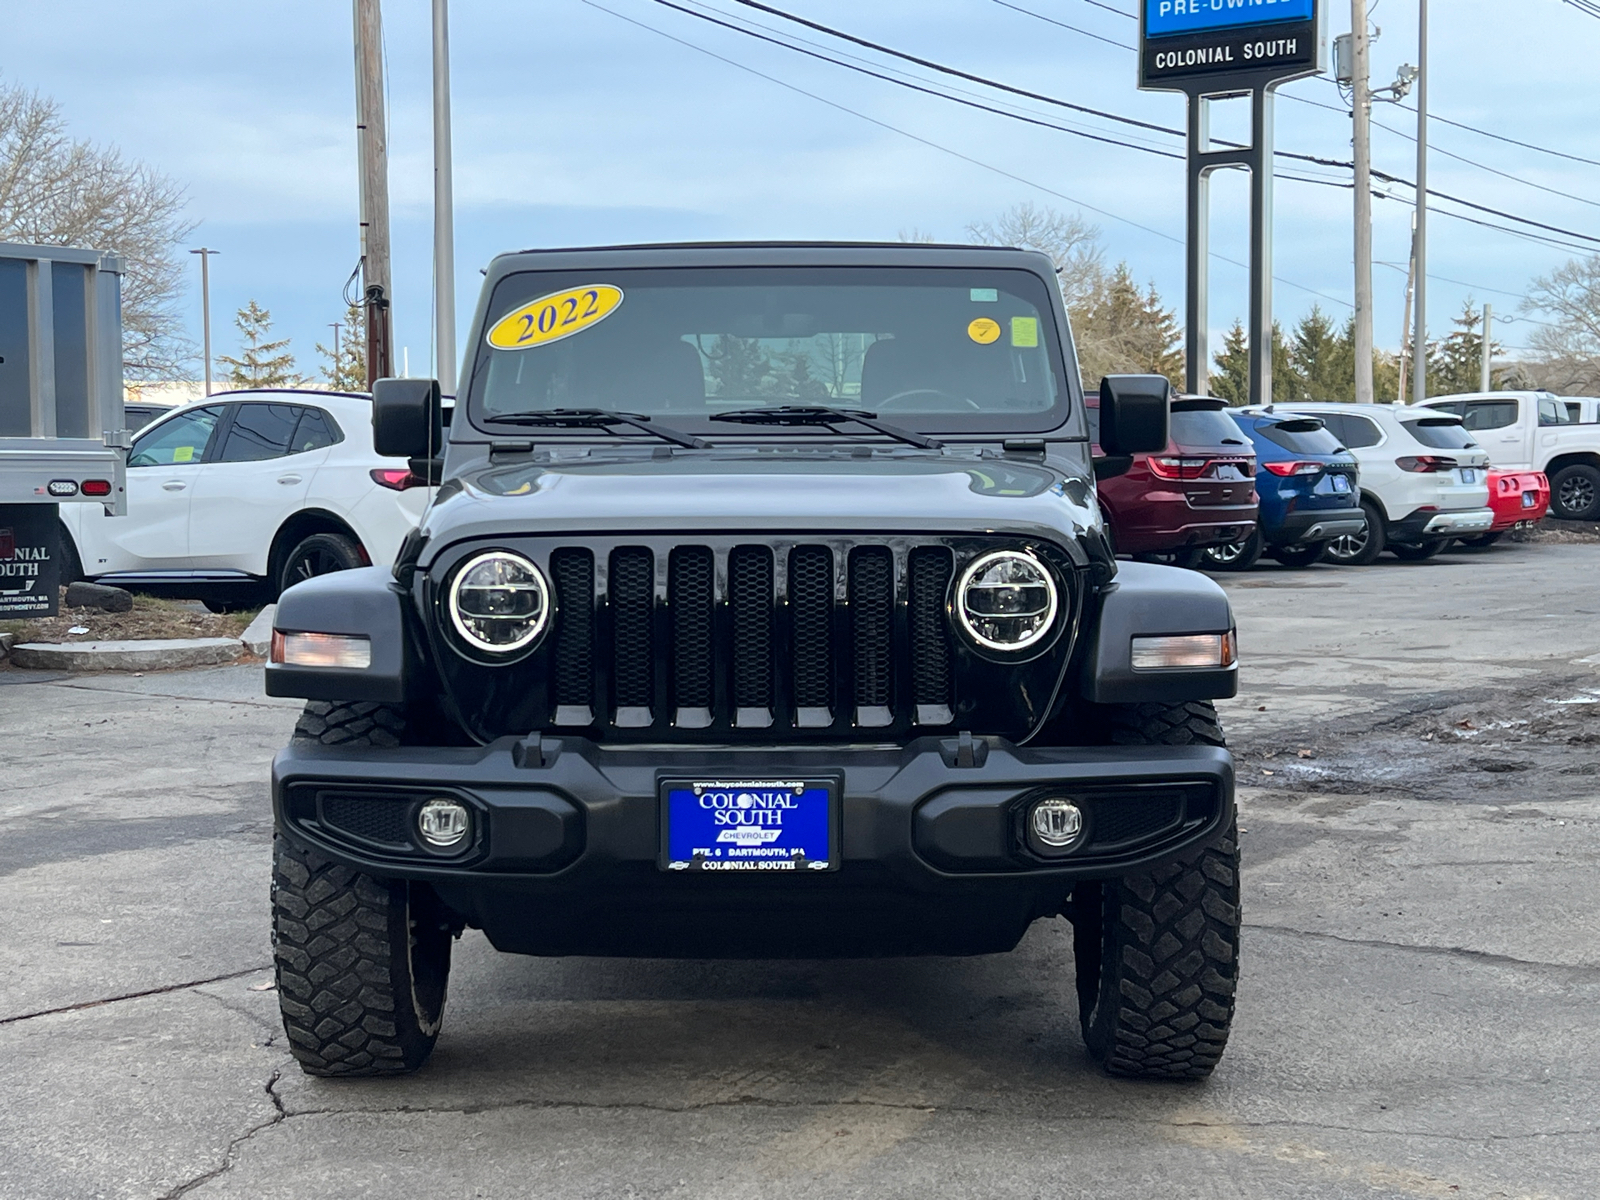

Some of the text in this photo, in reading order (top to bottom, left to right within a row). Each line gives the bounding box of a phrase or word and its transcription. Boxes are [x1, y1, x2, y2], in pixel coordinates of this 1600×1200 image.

[1155, 38, 1297, 69] COLONIAL SOUTH
[516, 290, 599, 343] 2022
[693, 781, 805, 789] www.buycolonialsouth.com
[699, 793, 798, 809] COLONIAL
[714, 809, 783, 825] SOUTH
[723, 831, 775, 840] CHEVROLET
[715, 848, 721, 857] 6
[728, 848, 789, 858] DARTMOUTH,
[702, 861, 796, 870] COLONIAL SOUTH
